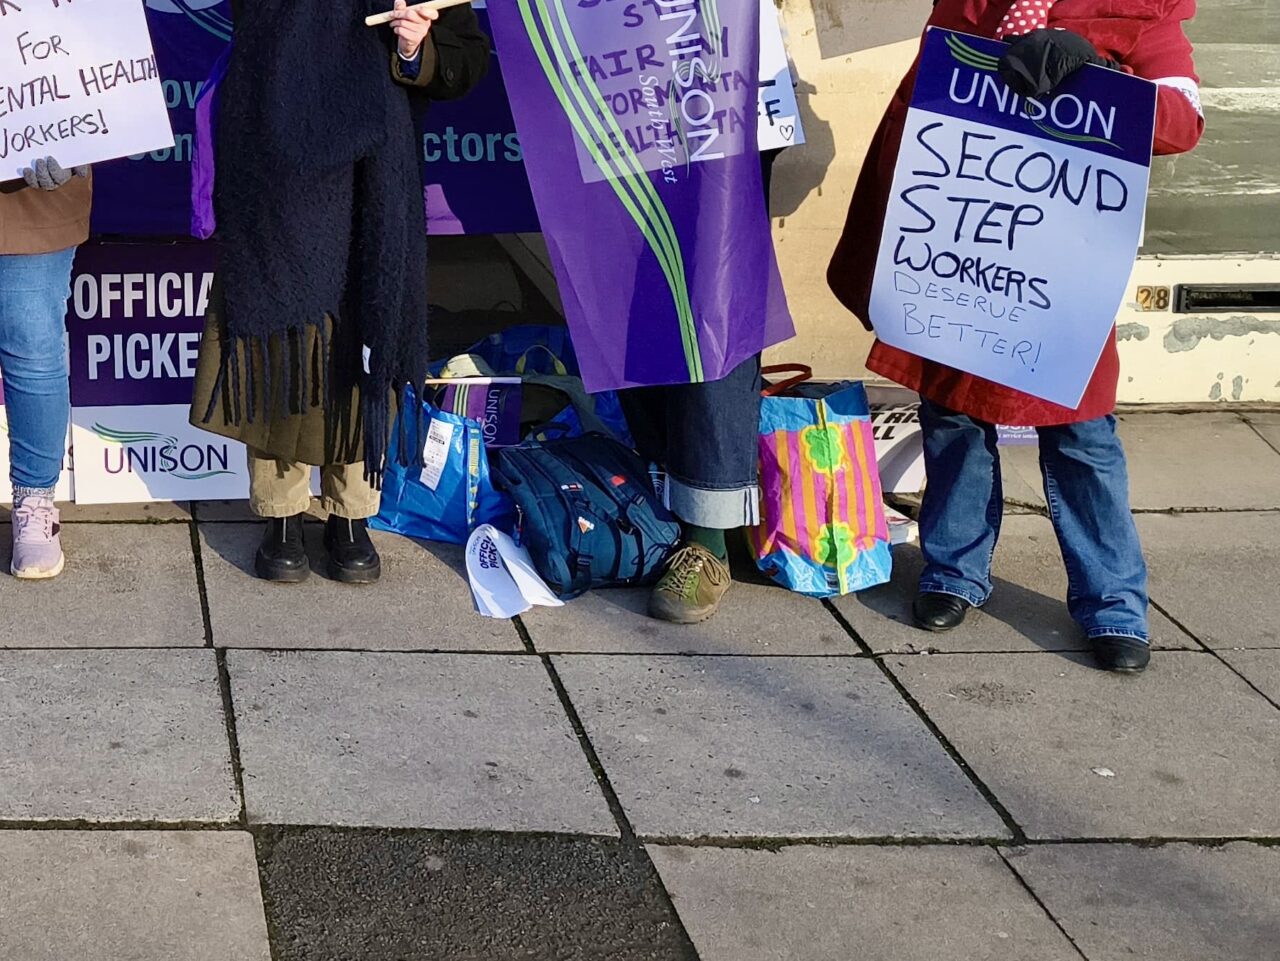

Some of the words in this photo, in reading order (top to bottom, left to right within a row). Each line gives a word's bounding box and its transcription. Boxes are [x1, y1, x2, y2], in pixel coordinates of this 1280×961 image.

[17, 31, 69, 65] FOR
[79, 54, 158, 96] HEALTH
[949, 68, 1116, 140] UNISON
[423, 126, 523, 162] ctors
[639, 75, 664, 134] South
[654, 137, 679, 183] West
[912, 122, 1127, 212] SECOND
[900, 184, 1044, 250] STEP
[74, 272, 214, 319] OFFICIA
[894, 236, 1051, 310] WORKERS
[894, 271, 1026, 322] DESERVE
[87, 332, 202, 380] PICKE
[902, 304, 1042, 373] BETTER!
[104, 444, 228, 473] UNISON
[479, 535, 492, 569] OFFICI
